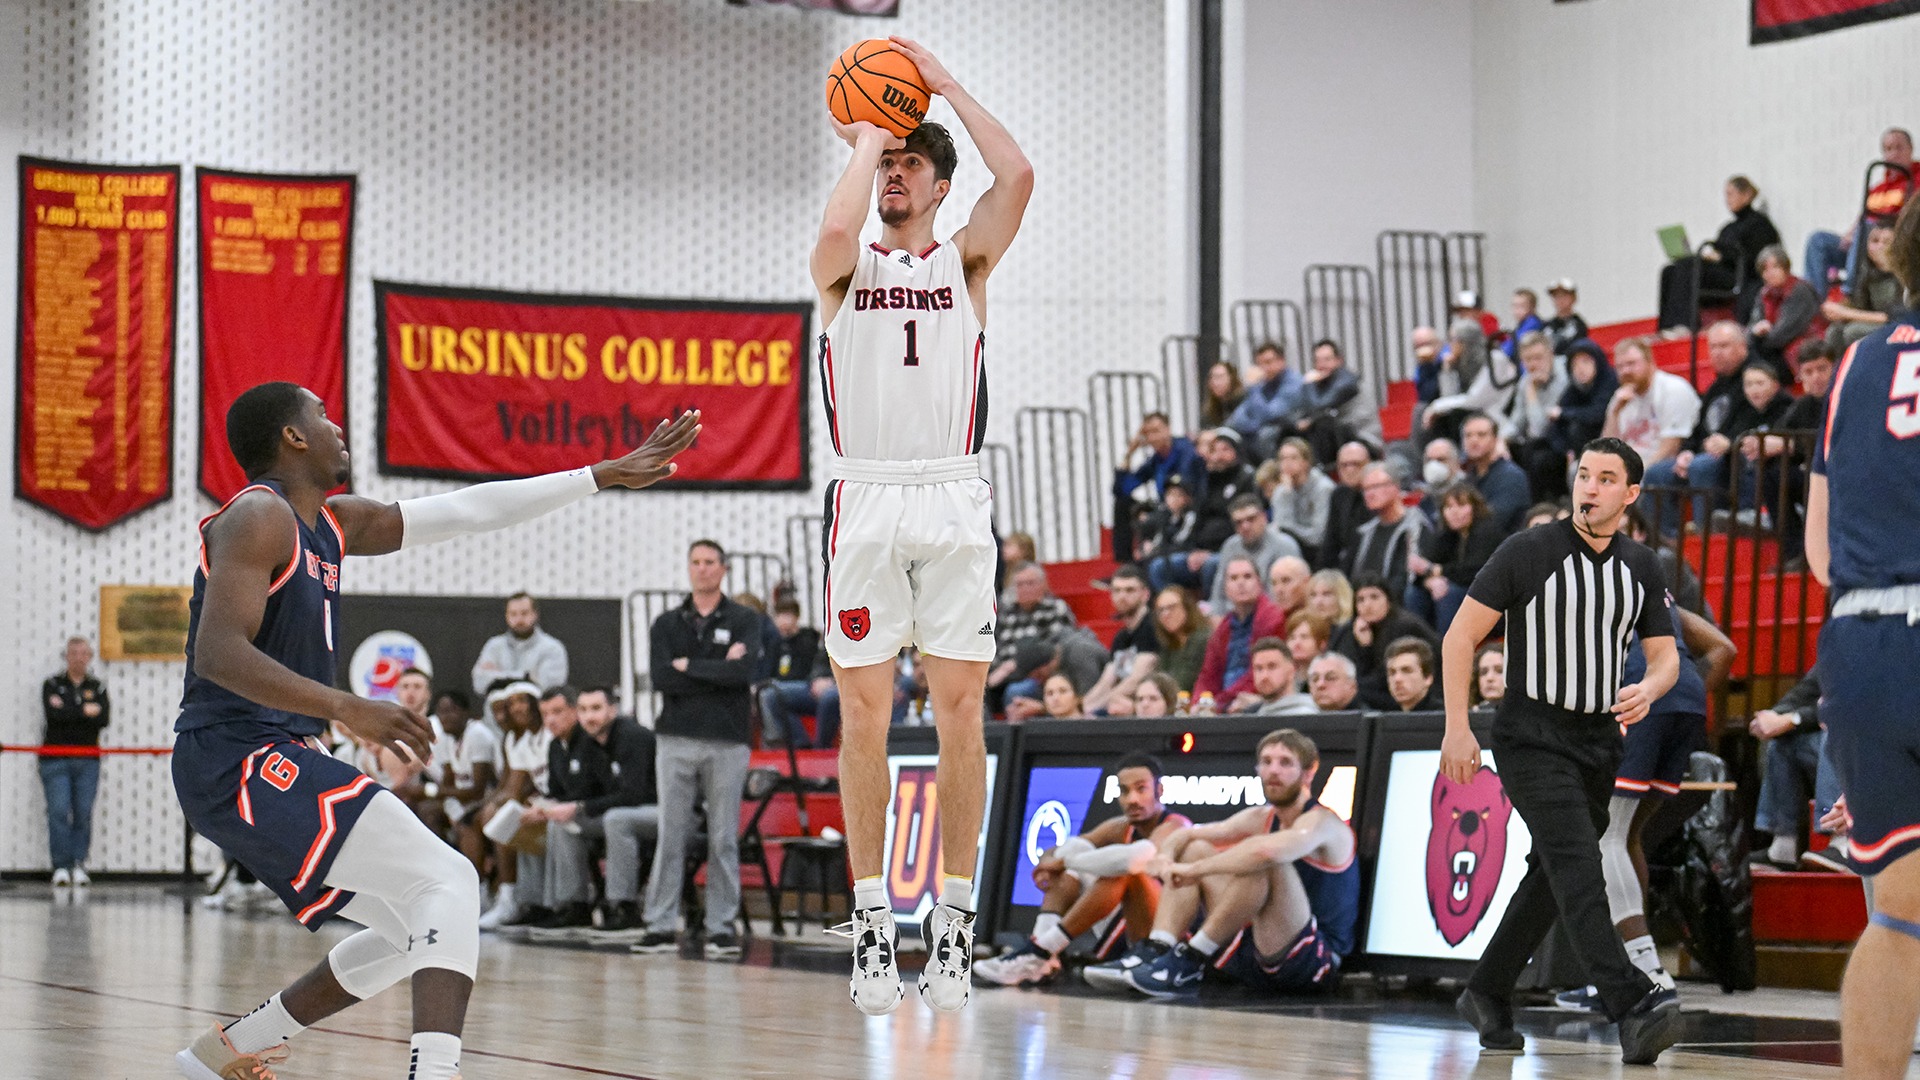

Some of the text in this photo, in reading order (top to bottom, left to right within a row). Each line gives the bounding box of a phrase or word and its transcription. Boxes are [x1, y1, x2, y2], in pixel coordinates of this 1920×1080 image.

[103, 175, 168, 197] COLLEGE
[855, 286, 954, 312] URSINUS
[400, 322, 793, 387] URSINUS COLLEGE
[903, 319, 919, 367] 1
[1885, 350, 1920, 441] 5
[497, 401, 699, 462] Volleyb
[260, 751, 300, 792] G
